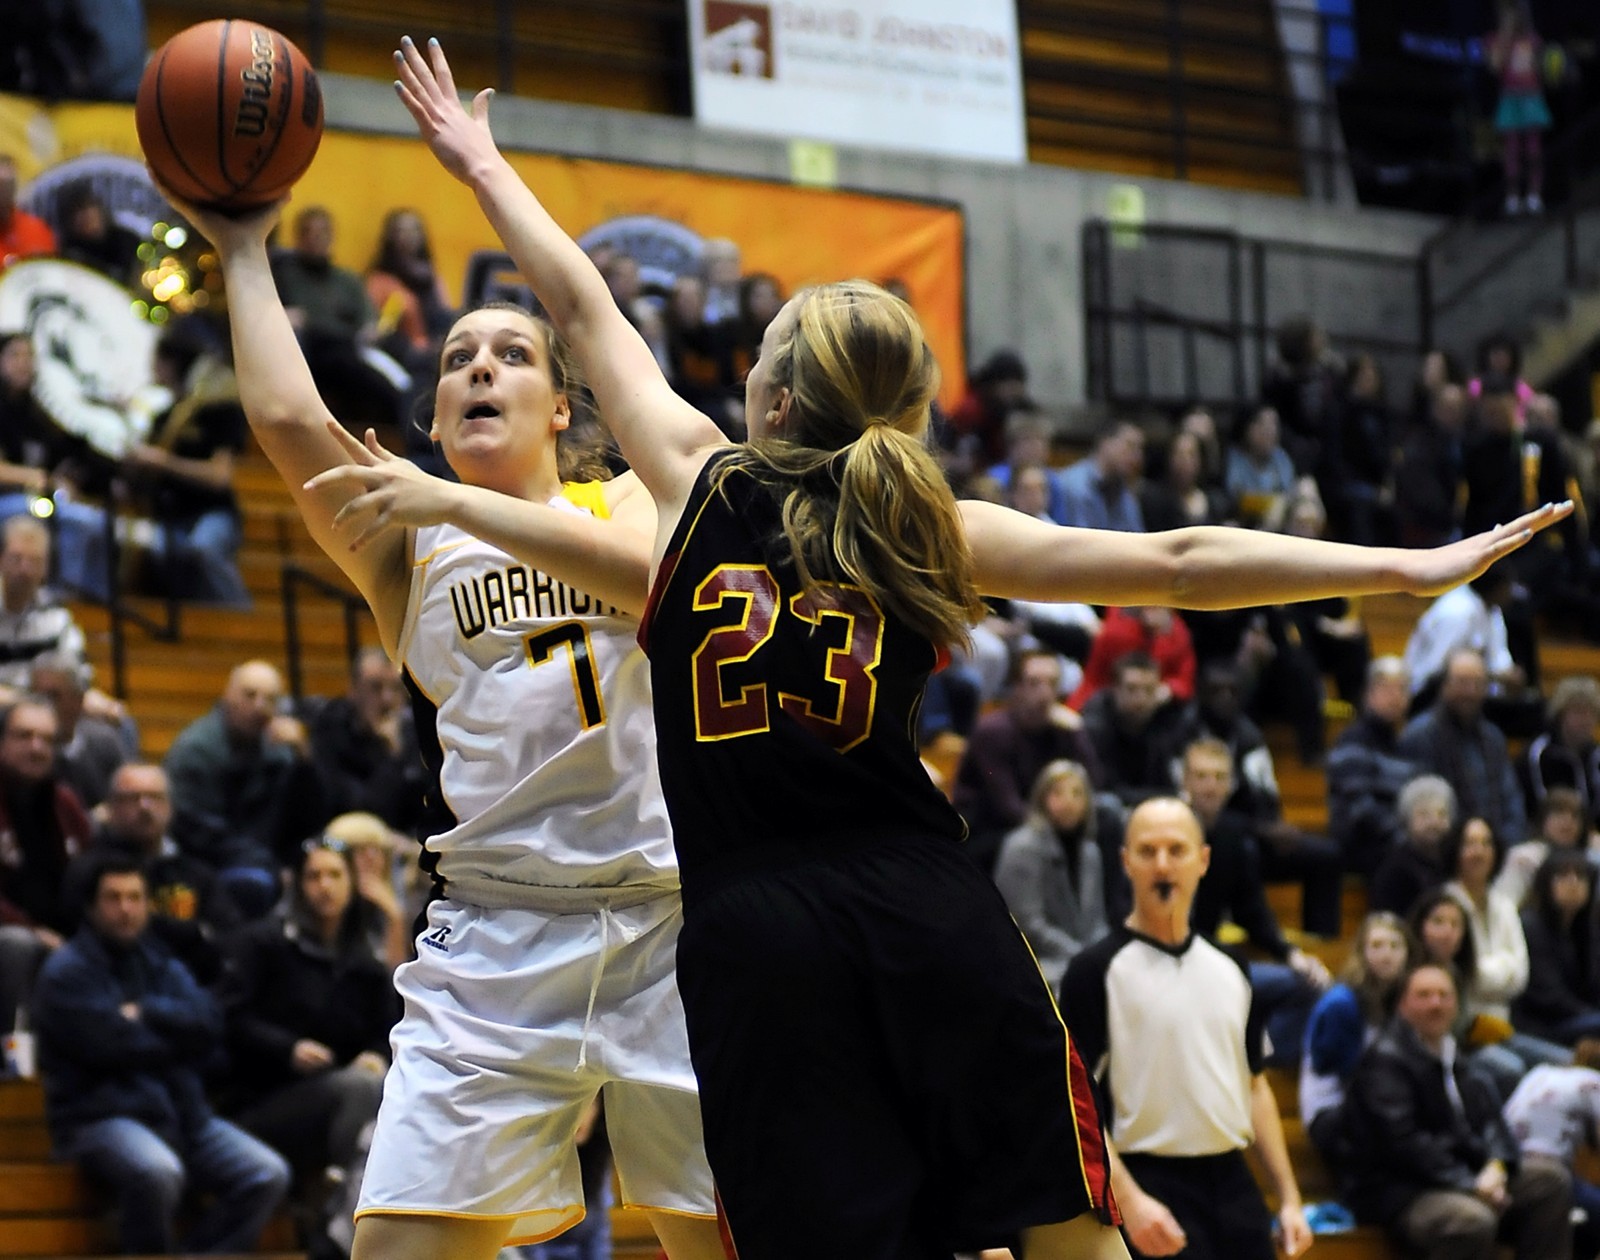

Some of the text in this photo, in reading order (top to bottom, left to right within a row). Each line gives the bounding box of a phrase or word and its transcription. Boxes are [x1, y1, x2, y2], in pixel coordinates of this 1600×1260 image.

[450, 565, 630, 639] WARRI
[692, 563, 885, 754] 23
[522, 619, 607, 732] 7
